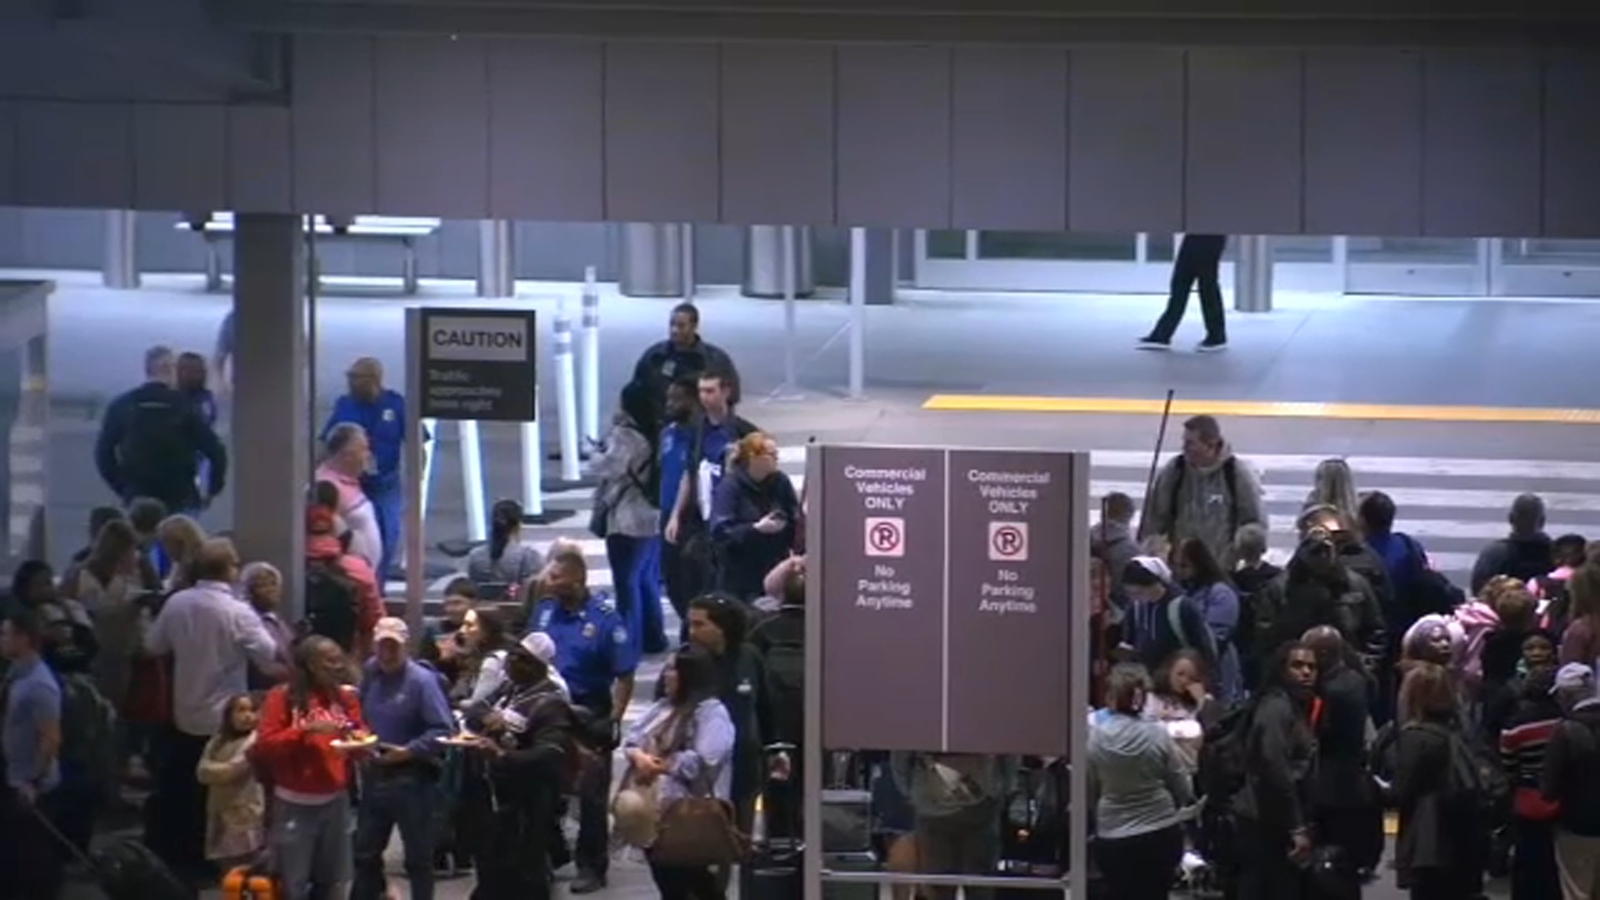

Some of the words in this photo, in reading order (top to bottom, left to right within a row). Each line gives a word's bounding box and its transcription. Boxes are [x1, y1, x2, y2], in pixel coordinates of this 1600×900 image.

[433, 328, 524, 348] CAUTION
[844, 465, 926, 481] Commercial
[968, 469, 1050, 484] Commercial
[856, 482, 914, 496] Vehicles
[979, 485, 1038, 499] Vehicles
[865, 497, 904, 510] ONLY
[989, 501, 1029, 514] ONLY
[874, 565, 895, 577] No
[998, 569, 1018, 582] No
[858, 580, 911, 595] Parking
[982, 584, 1034, 599] Parking
[856, 595, 913, 610] Anytime
[979, 599, 1036, 615] Anytime
